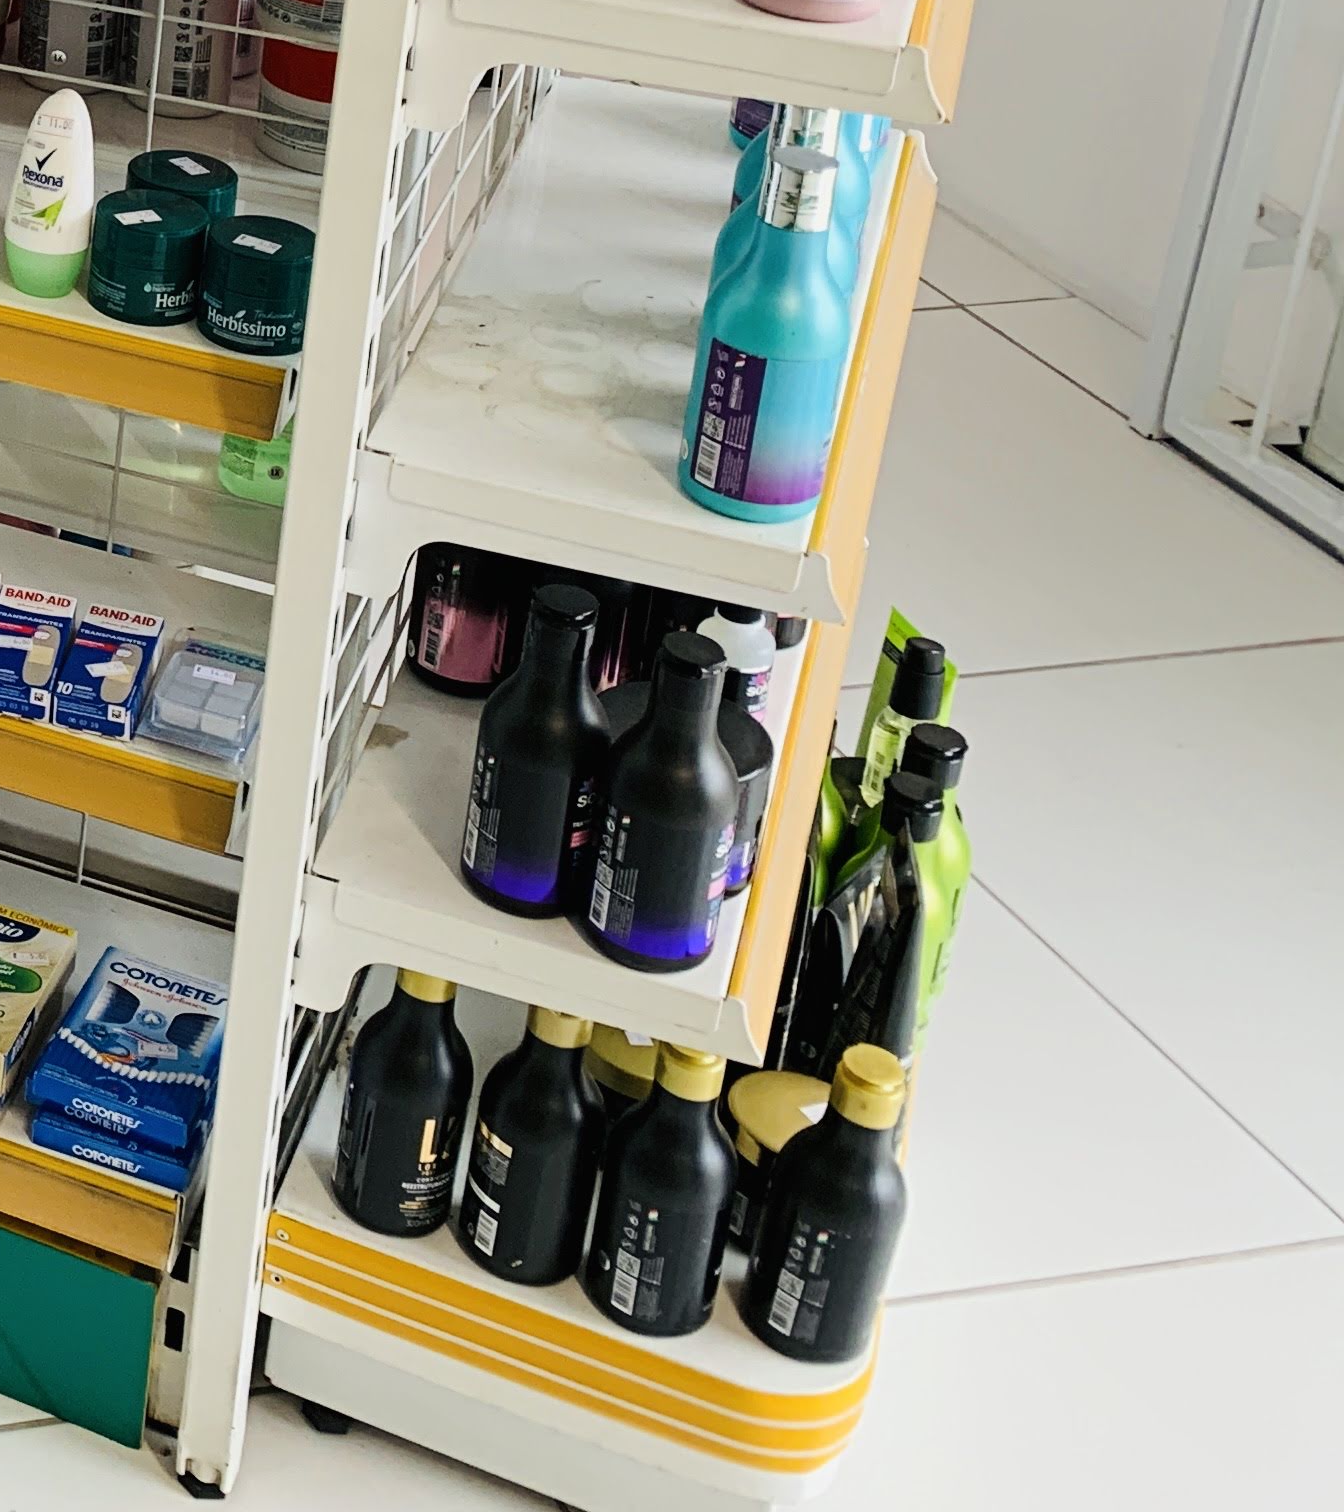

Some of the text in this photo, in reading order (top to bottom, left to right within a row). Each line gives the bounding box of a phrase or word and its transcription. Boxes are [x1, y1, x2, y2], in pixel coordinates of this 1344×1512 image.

[207, 307, 286, 339] Herbíssimo
[5, 588, 71, 607] BAND-AID
[90, 606, 156, 627] BAND-AID
[57, 681, 73, 695] 10
[110, 961, 227, 1007] COTONETES
[72, 1144, 144, 1173] COTONETES
